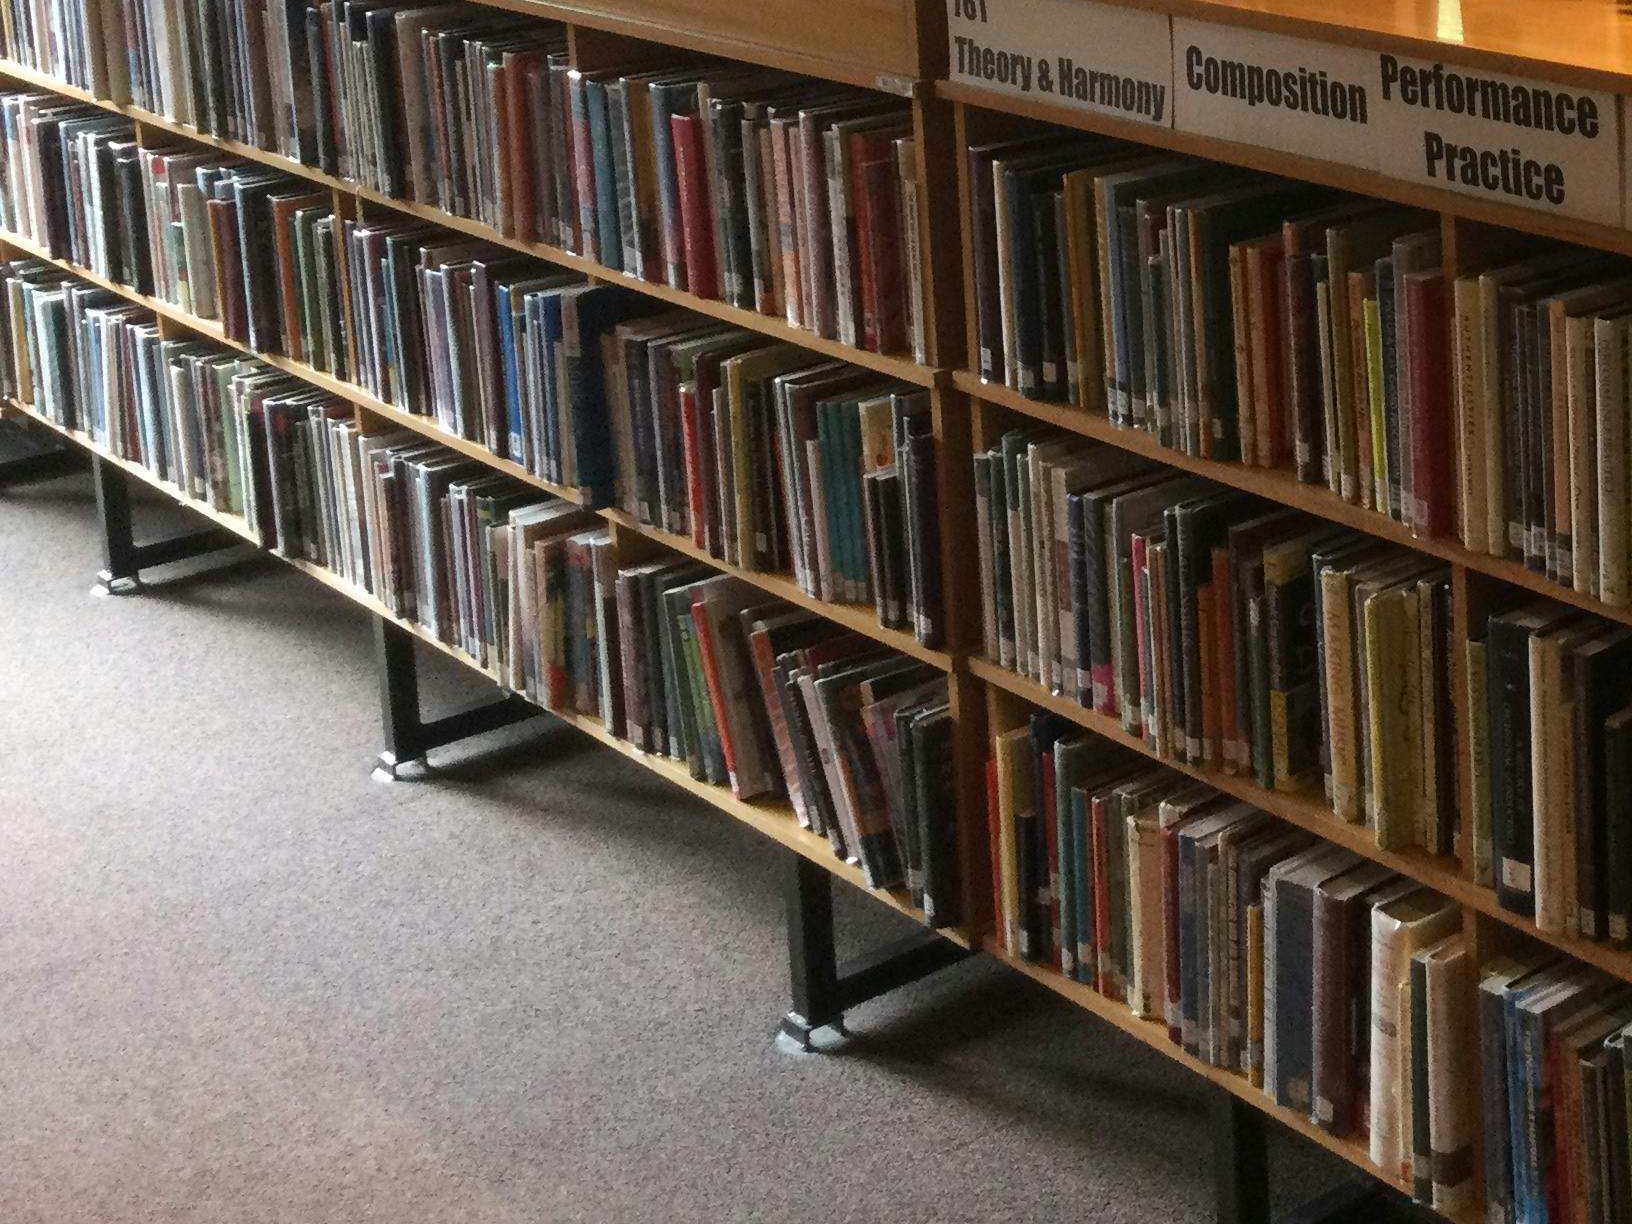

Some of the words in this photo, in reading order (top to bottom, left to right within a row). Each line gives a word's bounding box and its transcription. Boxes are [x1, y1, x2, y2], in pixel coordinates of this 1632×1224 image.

[953, 35, 1034, 94] Theory
[1037, 59, 1054, 94] &
[1057, 55, 1167, 124] Harmony
[1185, 44, 1370, 126] Composition
[1379, 52, 1601, 141] Performance
[1423, 130, 1567, 207] Practice
